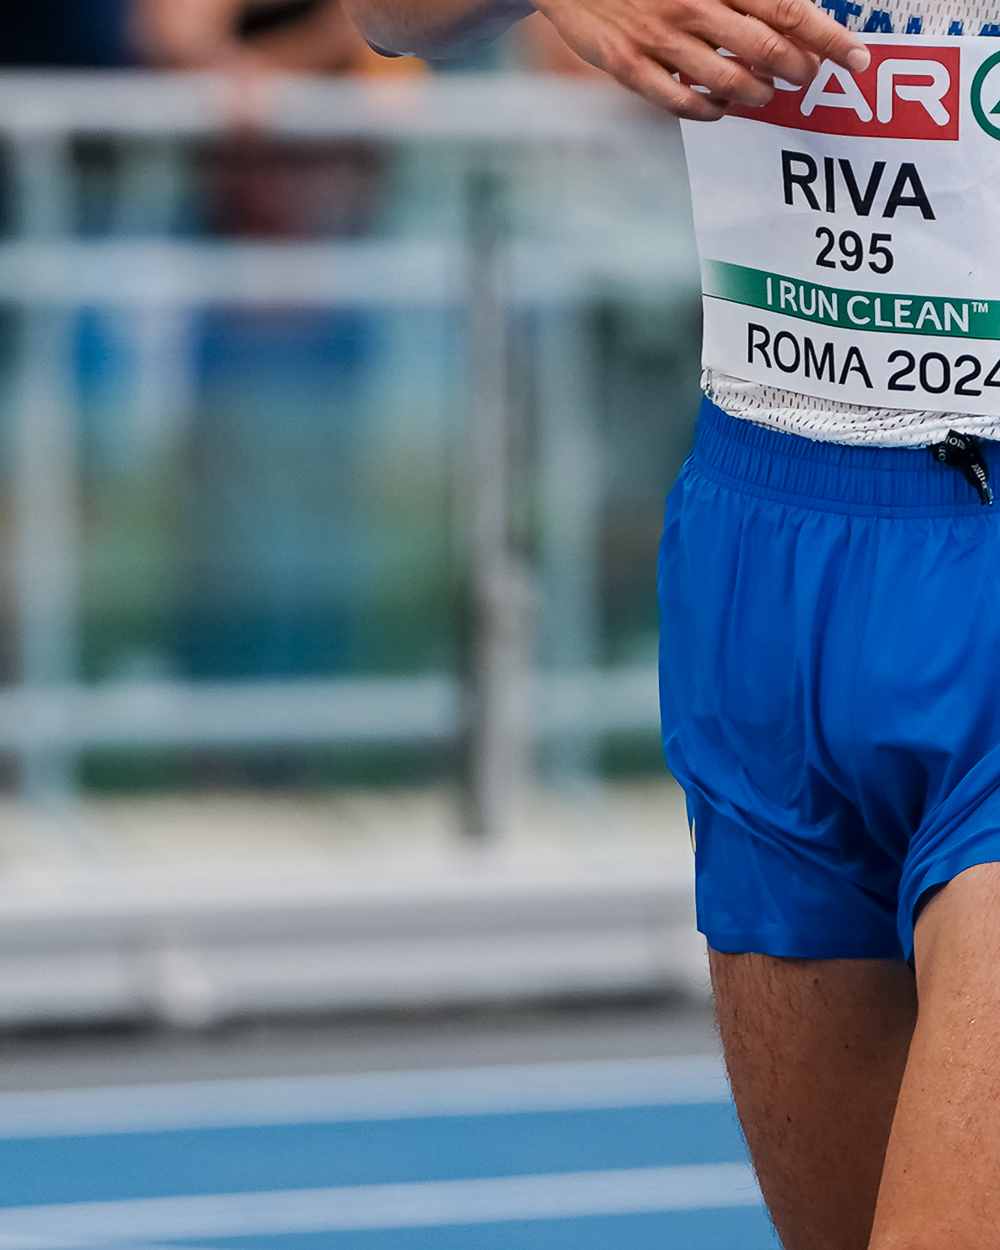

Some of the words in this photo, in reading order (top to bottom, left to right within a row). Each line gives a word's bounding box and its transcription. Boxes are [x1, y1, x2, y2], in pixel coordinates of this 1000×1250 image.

[781, 149, 937, 220] RIVA
[815, 226, 894, 275] 295
[766, 277, 773, 306] I
[779, 280, 838, 321] RUN
[747, 322, 874, 389] ROMA
